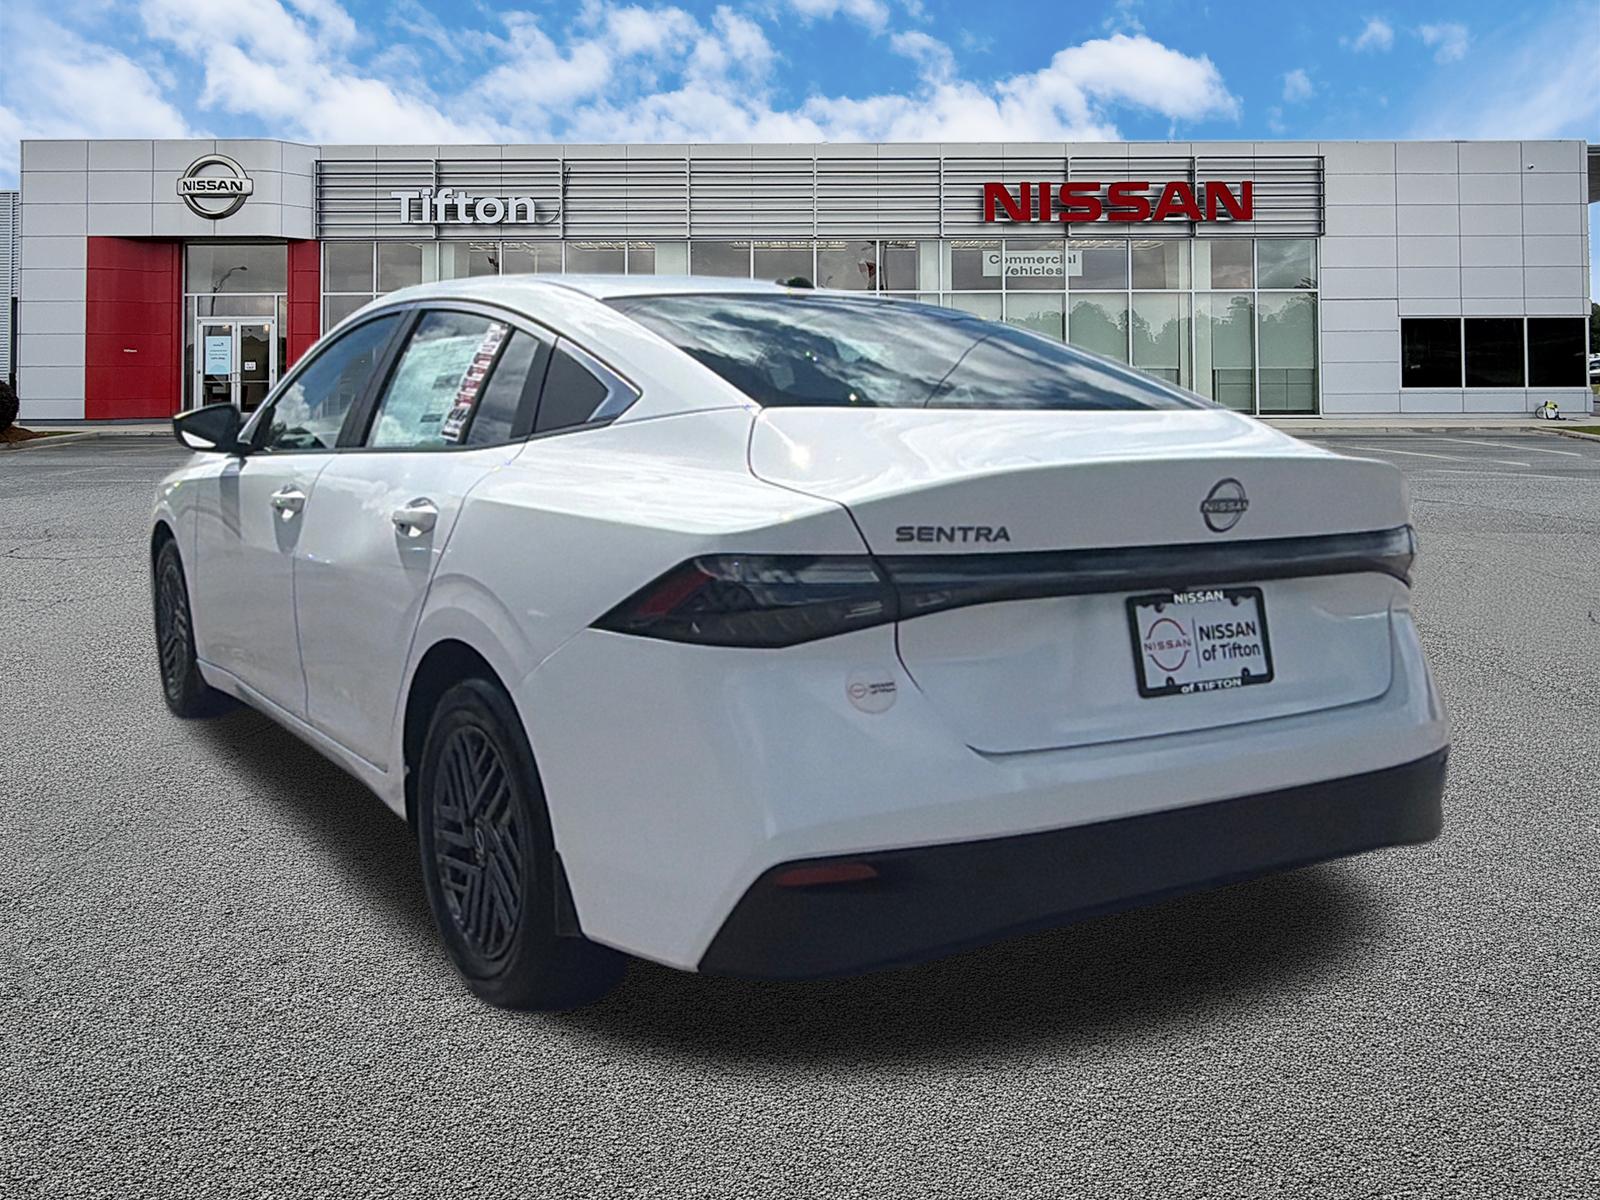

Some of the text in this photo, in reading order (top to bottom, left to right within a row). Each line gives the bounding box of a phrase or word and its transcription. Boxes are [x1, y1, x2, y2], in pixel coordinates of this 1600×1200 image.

[182, 179, 244, 192] NISSAN
[391, 187, 536, 224] Tifton
[983, 180, 1254, 223] NISSAN
[989, 254, 1077, 265] Cmmercil
[895, 526, 1011, 543] SENTRA
[1173, 590, 1225, 604] NISSAN
[1199, 621, 1257, 641] NISSAN
[1144, 638, 1192, 651] NISSAN
[1202, 643, 1261, 661] of Tifton
[1181, 678, 1242, 694] of TIFTON
